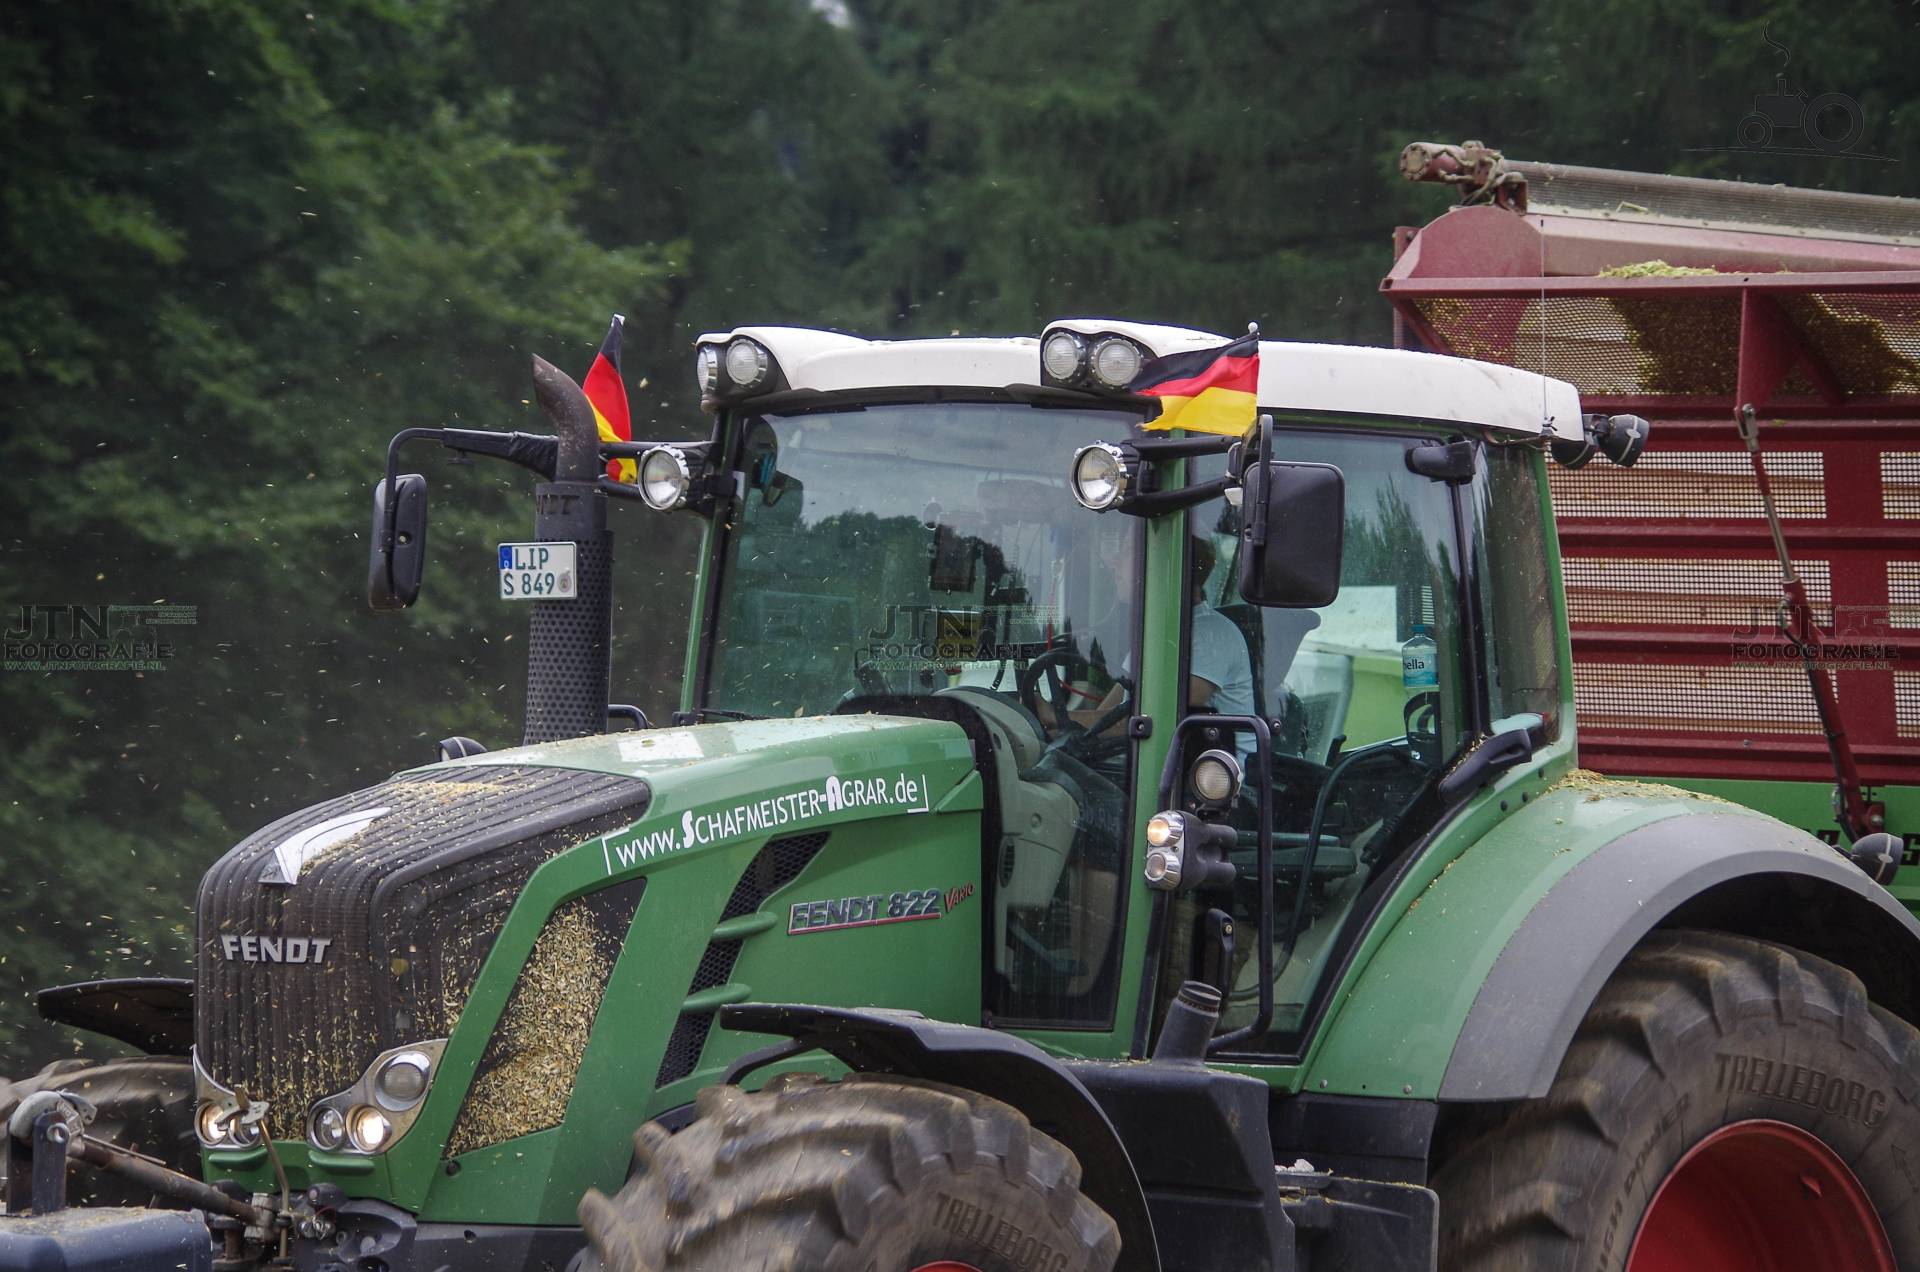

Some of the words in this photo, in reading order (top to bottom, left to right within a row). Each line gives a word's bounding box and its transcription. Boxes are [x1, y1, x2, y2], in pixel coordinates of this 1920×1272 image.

[515, 548, 549, 570] LIP
[503, 573, 514, 595] S
[522, 572, 555, 595] 849
[788, 896, 883, 930] FENDT
[888, 888, 942, 918] 822
[221, 935, 331, 964] FENDT
[1714, 1052, 1889, 1128] TRELLEBORG
[1592, 1201, 1624, 1272] IGH
